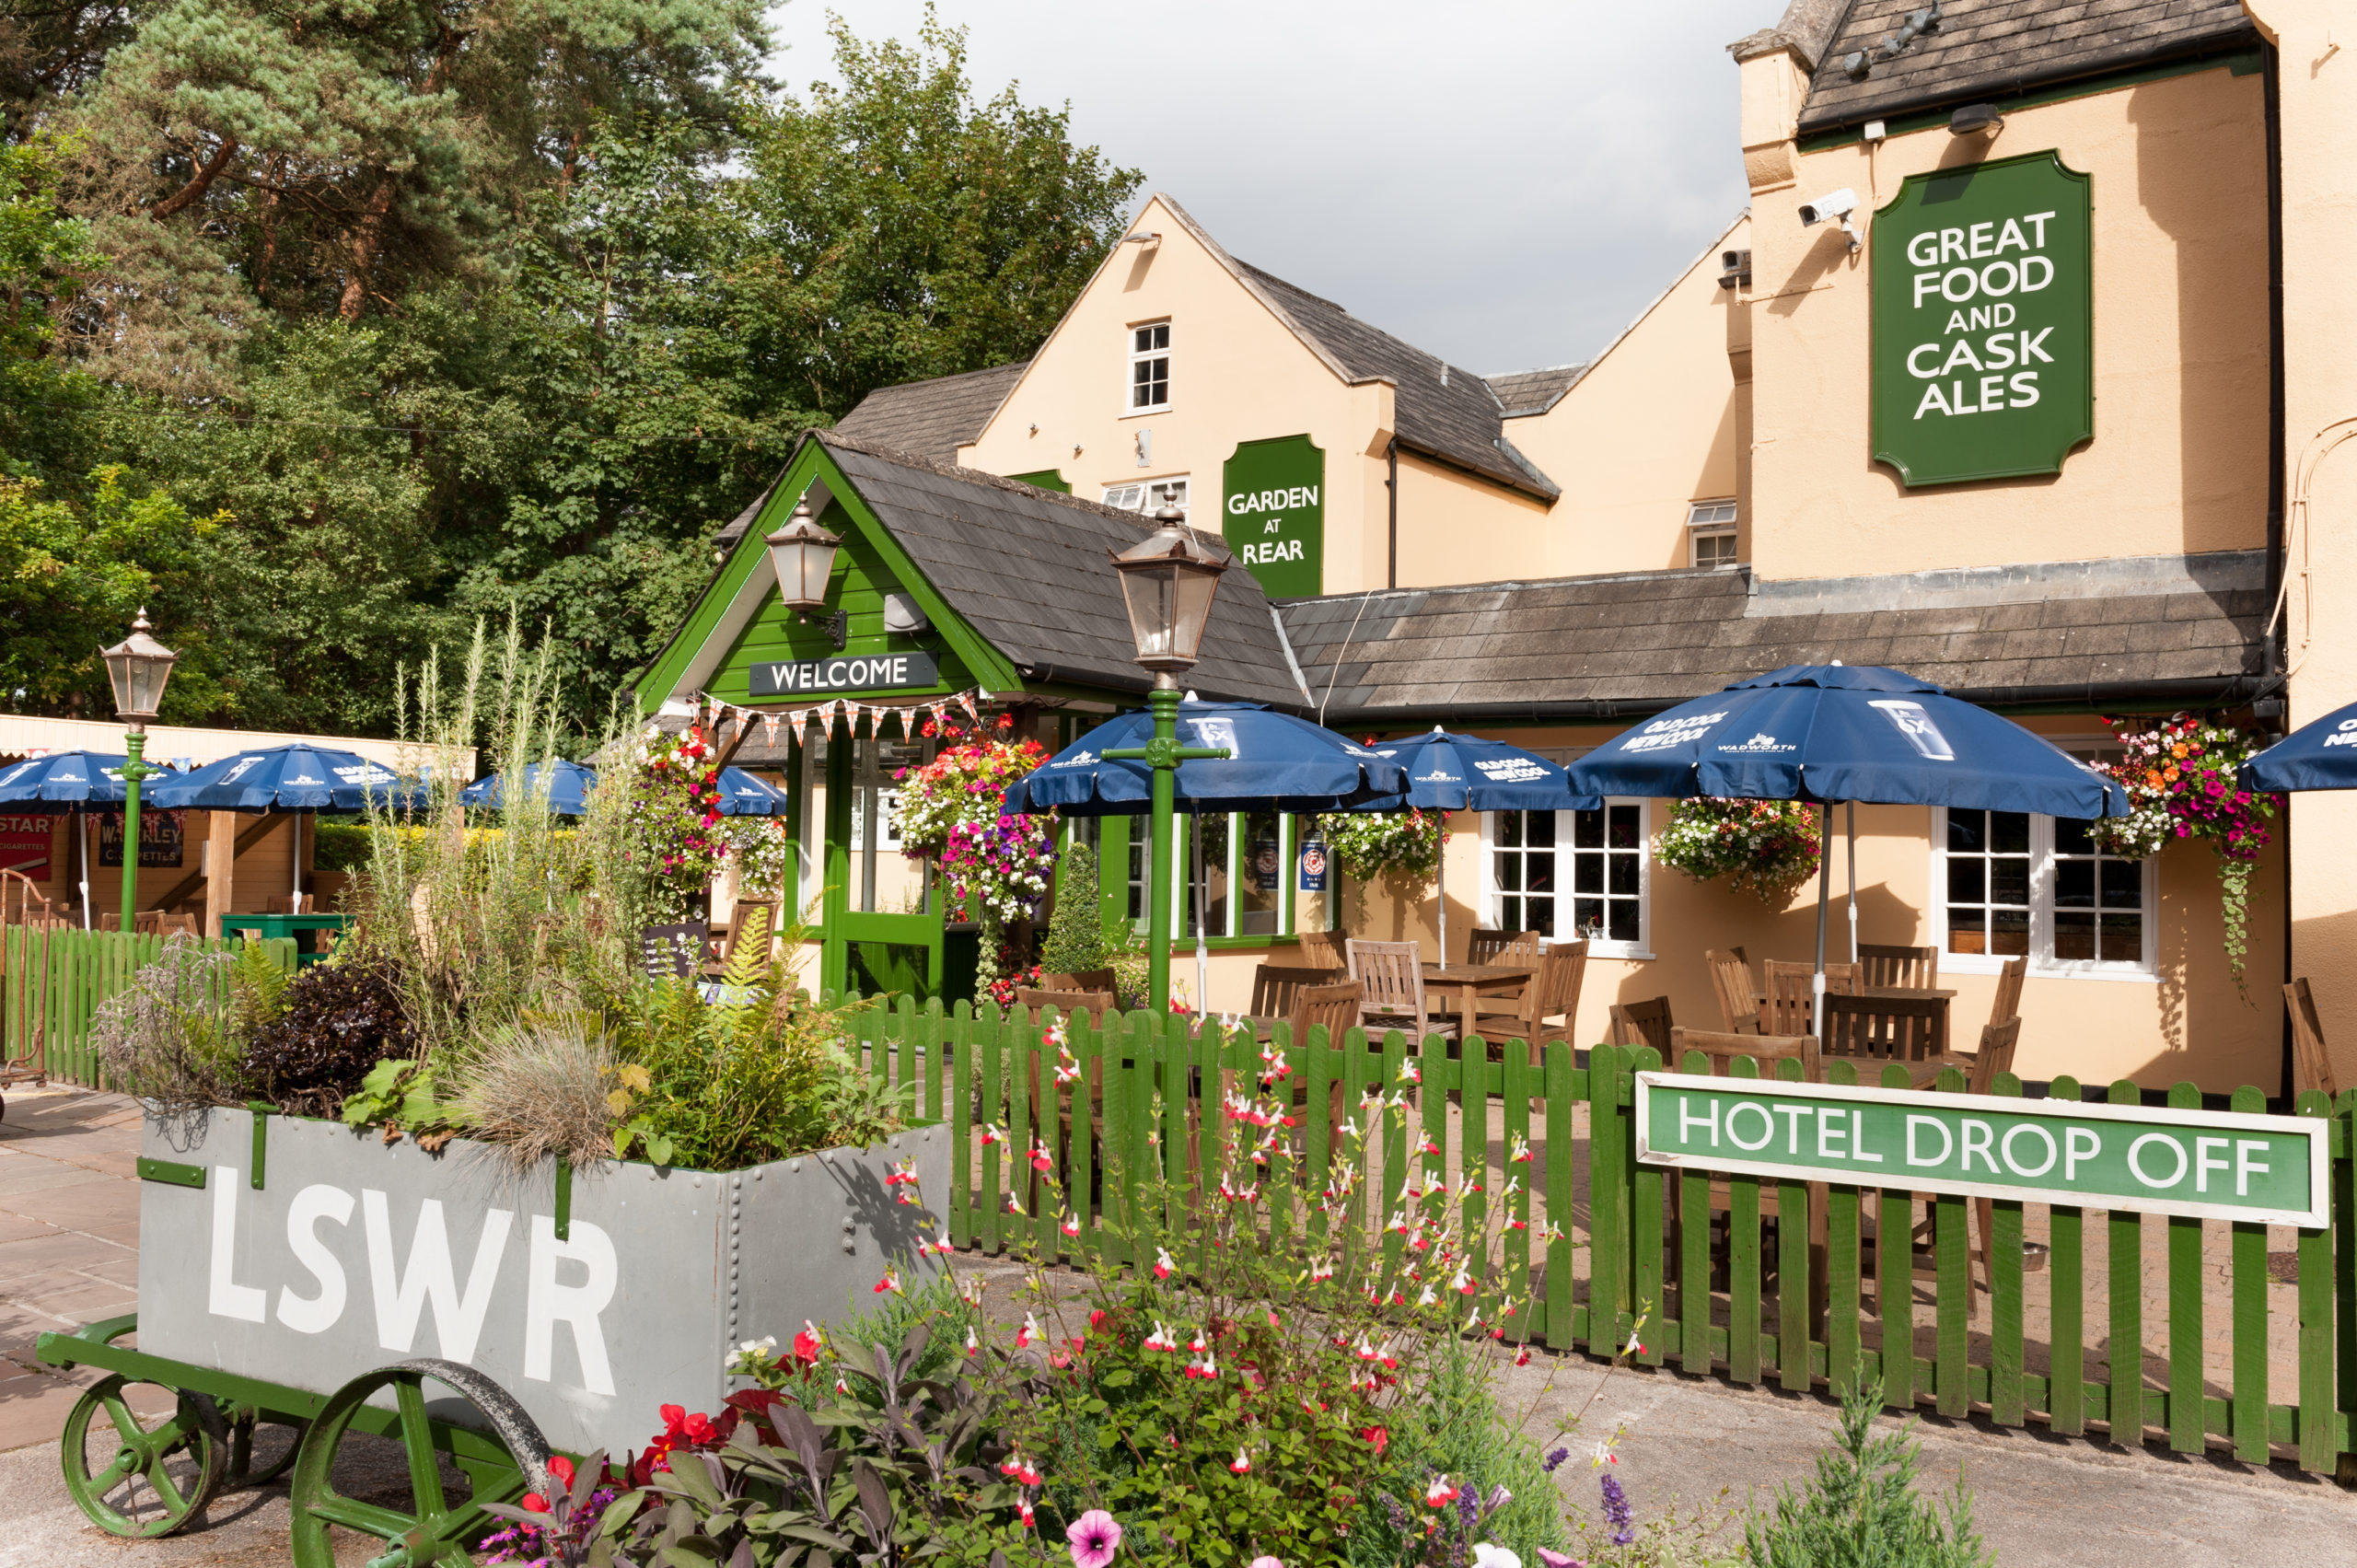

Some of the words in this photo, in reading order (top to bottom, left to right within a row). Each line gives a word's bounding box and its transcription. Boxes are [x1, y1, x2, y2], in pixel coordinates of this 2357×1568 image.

[1907, 210, 2056, 267] GREAT
[1913, 255, 2055, 309] FOOD
[1944, 302, 2016, 335] AND
[1906, 326, 2055, 379] CASK
[1912, 370, 2040, 420] ALES
[1227, 484, 1318, 516] GARDEN
[1263, 518, 1281, 534] AT
[1243, 539, 1305, 564] REAR
[772, 656, 909, 691] WELCOME
[1717, 744, 1796, 752] WADWORTH
[1679, 1097, 1884, 1164] HOTEL
[1906, 1114, 2102, 1181] DROP
[2127, 1132, 2270, 1196] OFF
[209, 1166, 618, 1396] LSWR
